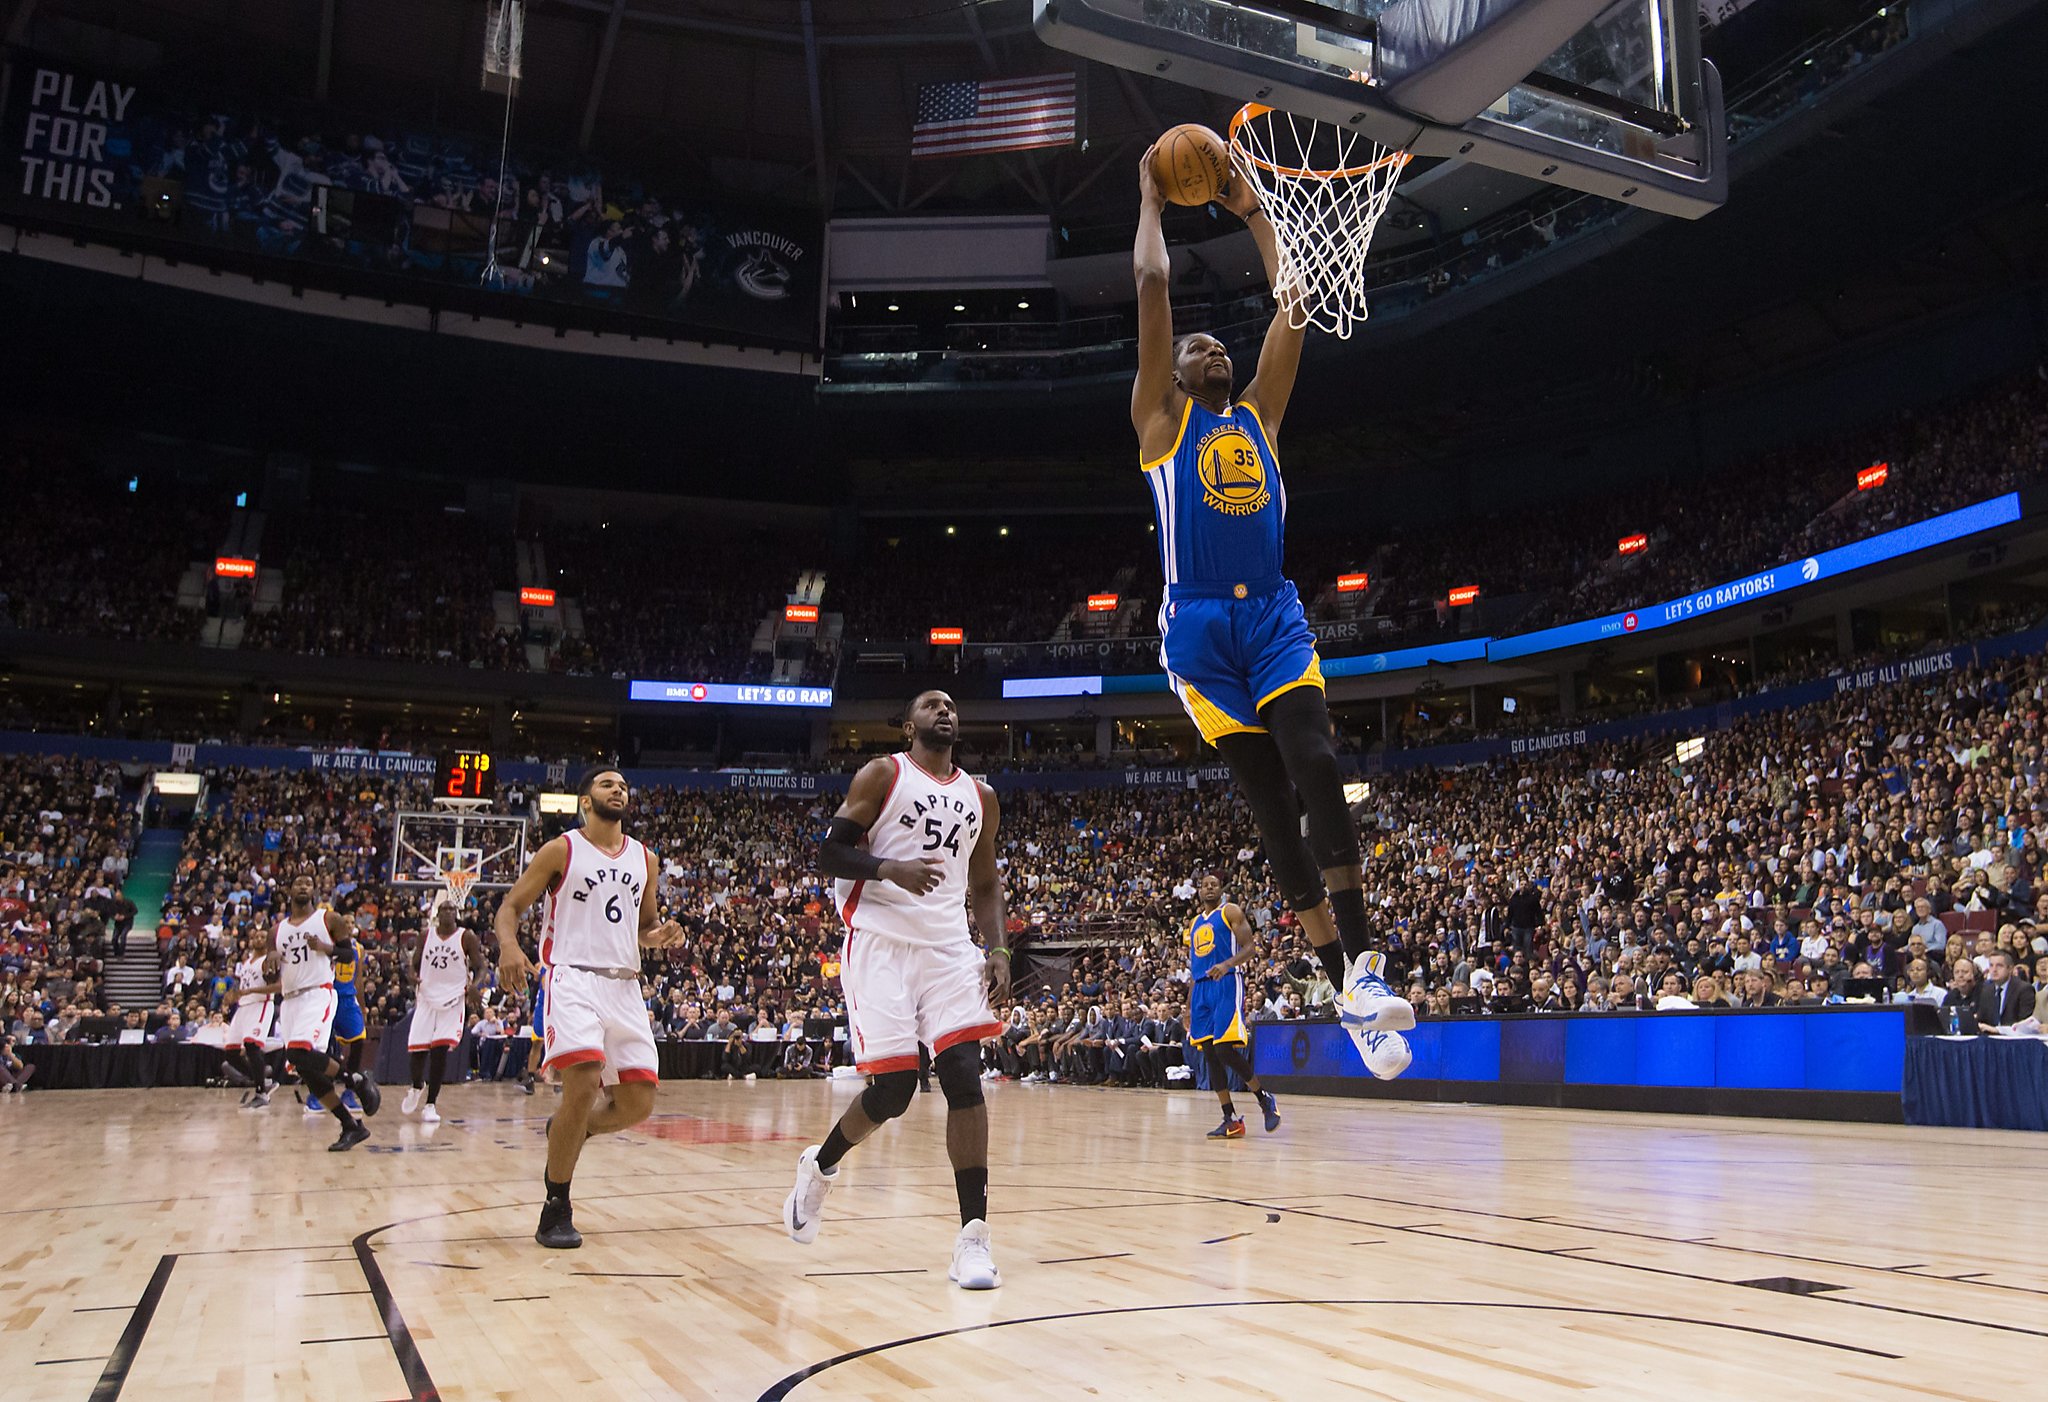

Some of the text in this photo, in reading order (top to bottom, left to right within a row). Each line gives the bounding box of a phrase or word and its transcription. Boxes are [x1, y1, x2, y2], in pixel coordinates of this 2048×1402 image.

[31, 69, 136, 122] PLAY
[24, 112, 107, 162] FOR
[20, 156, 122, 210] THIS.
[726, 231, 804, 261] VANCOUVER
[1196, 423, 1235, 452] GOLDEN
[1234, 448, 1255, 467] 35
[1203, 490, 1271, 516] WARRIORS
[225, 563, 253, 573] ROGERS
[528, 593, 553, 601] ROGERS
[1601, 574, 1775, 633] BMO LET'S GO RAPTORS!
[1836, 676, 1852, 693] WE
[1855, 671, 1874, 688] ARE
[1878, 665, 1897, 683] ALL
[666, 688, 689, 697] BMO
[737, 687, 772, 702] LET'S
[777, 688, 796, 702] GO
[1511, 730, 1586, 753] GO CANUCKS GO
[312, 753, 329, 768] WE
[333, 755, 356, 769] ARE
[361, 756, 382, 770] ALL
[447, 767, 483, 796] 21
[731, 774, 815, 789] GO CANUCKS GO
[1125, 772, 1139, 784] WE
[1143, 771, 1161, 783] ARE
[1165, 770, 1182, 783] ALL
[922, 818, 961, 858] 54
[573, 869, 640, 908] RAPTORS
[605, 894, 622, 923] 6
[291, 945, 308, 965] 31
[425, 945, 460, 962] RAPTORS
[431, 956, 448, 969] 43
